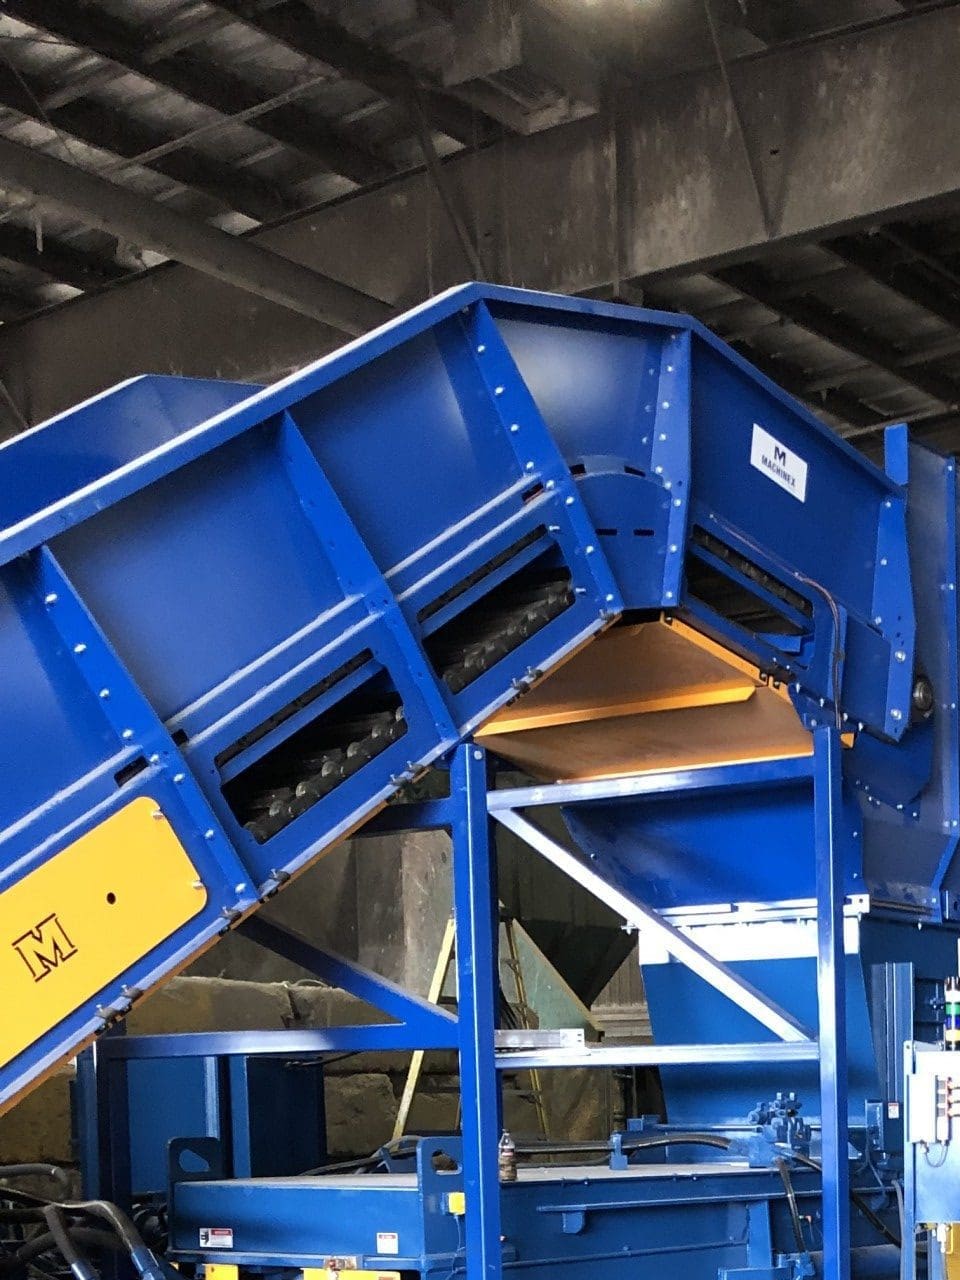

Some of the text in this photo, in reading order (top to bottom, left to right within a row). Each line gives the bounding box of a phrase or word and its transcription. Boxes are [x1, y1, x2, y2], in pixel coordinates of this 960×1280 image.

[761, 454, 796, 487] MACHINEX
[774, 446, 786, 466] M
[12, 912, 78, 982] M
